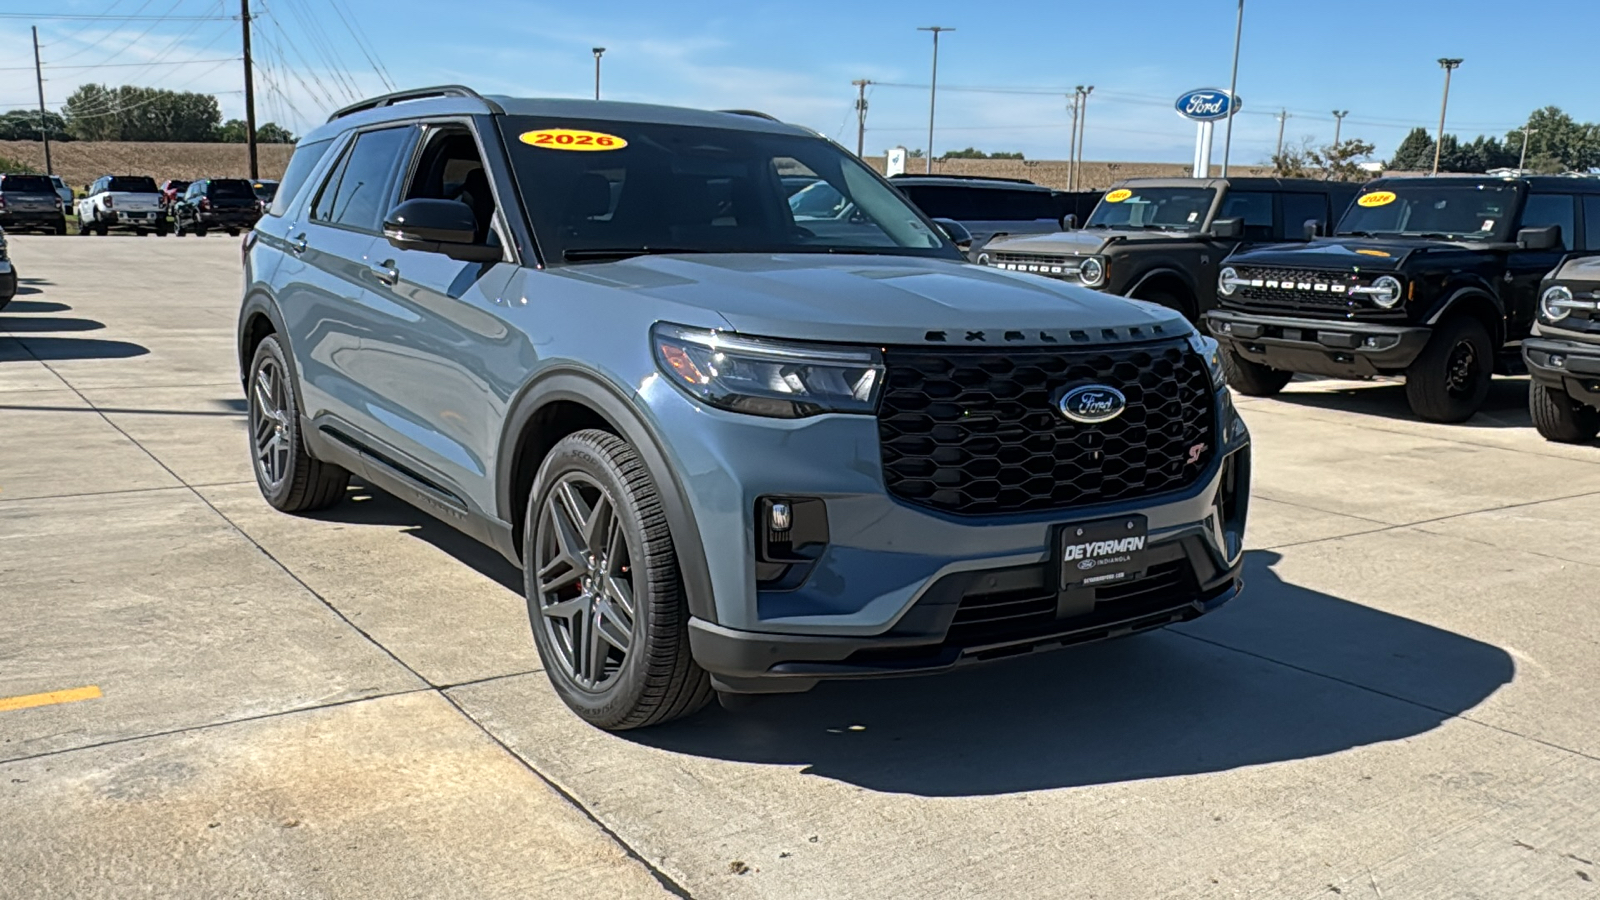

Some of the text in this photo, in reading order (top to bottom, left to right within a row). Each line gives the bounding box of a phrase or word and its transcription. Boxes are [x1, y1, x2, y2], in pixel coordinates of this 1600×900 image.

[1186, 94, 1223, 113] Ford
[534, 133, 614, 146] 2026
[1362, 194, 1392, 204] 2026
[1251, 280, 1346, 292] BRONCO
[1079, 393, 1113, 414] Ford
[1064, 536, 1146, 562] DEYARMAN
[1096, 555, 1131, 566] INDIANOLA
